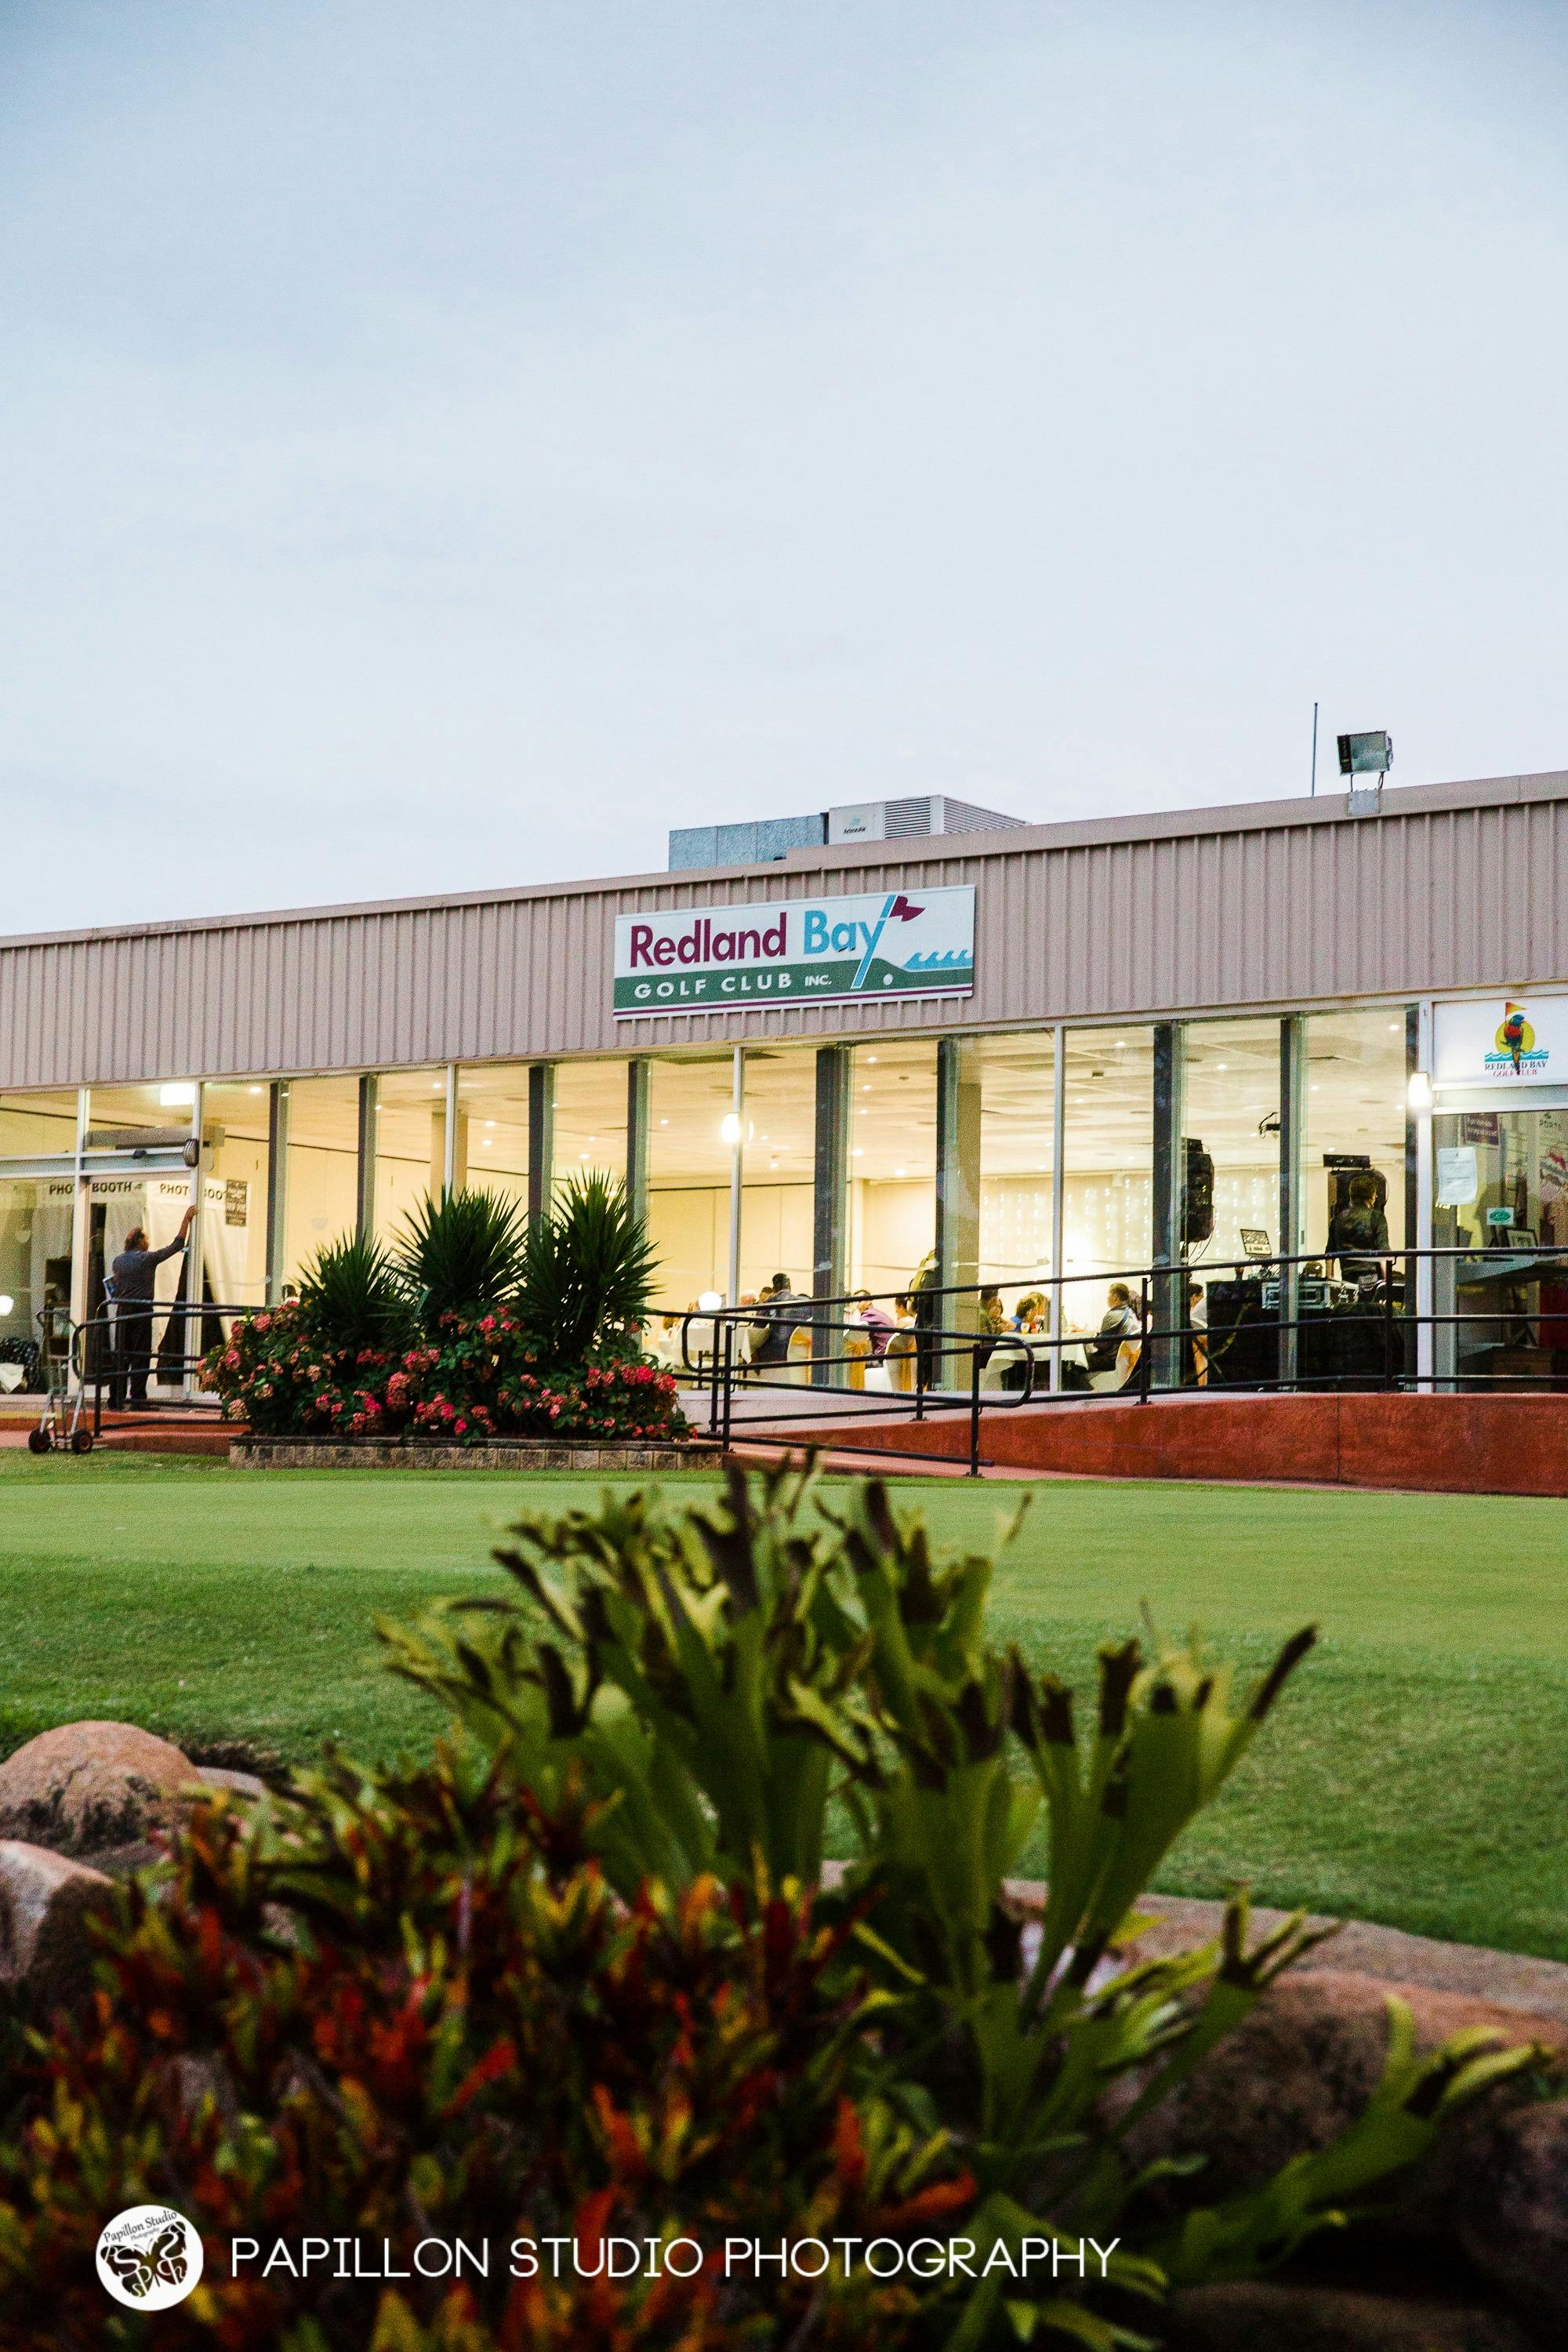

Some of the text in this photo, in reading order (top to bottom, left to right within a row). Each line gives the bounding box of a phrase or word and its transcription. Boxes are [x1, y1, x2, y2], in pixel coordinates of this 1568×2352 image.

[630, 909, 886, 989] Redland Bay
[634, 972, 832, 999] GOLF CLUB INC.
[1485, 1060, 1527, 1070] REDLAD
[49, 1181, 132, 1196] PHO BOOTH
[160, 1183, 190, 1196] PHOT
